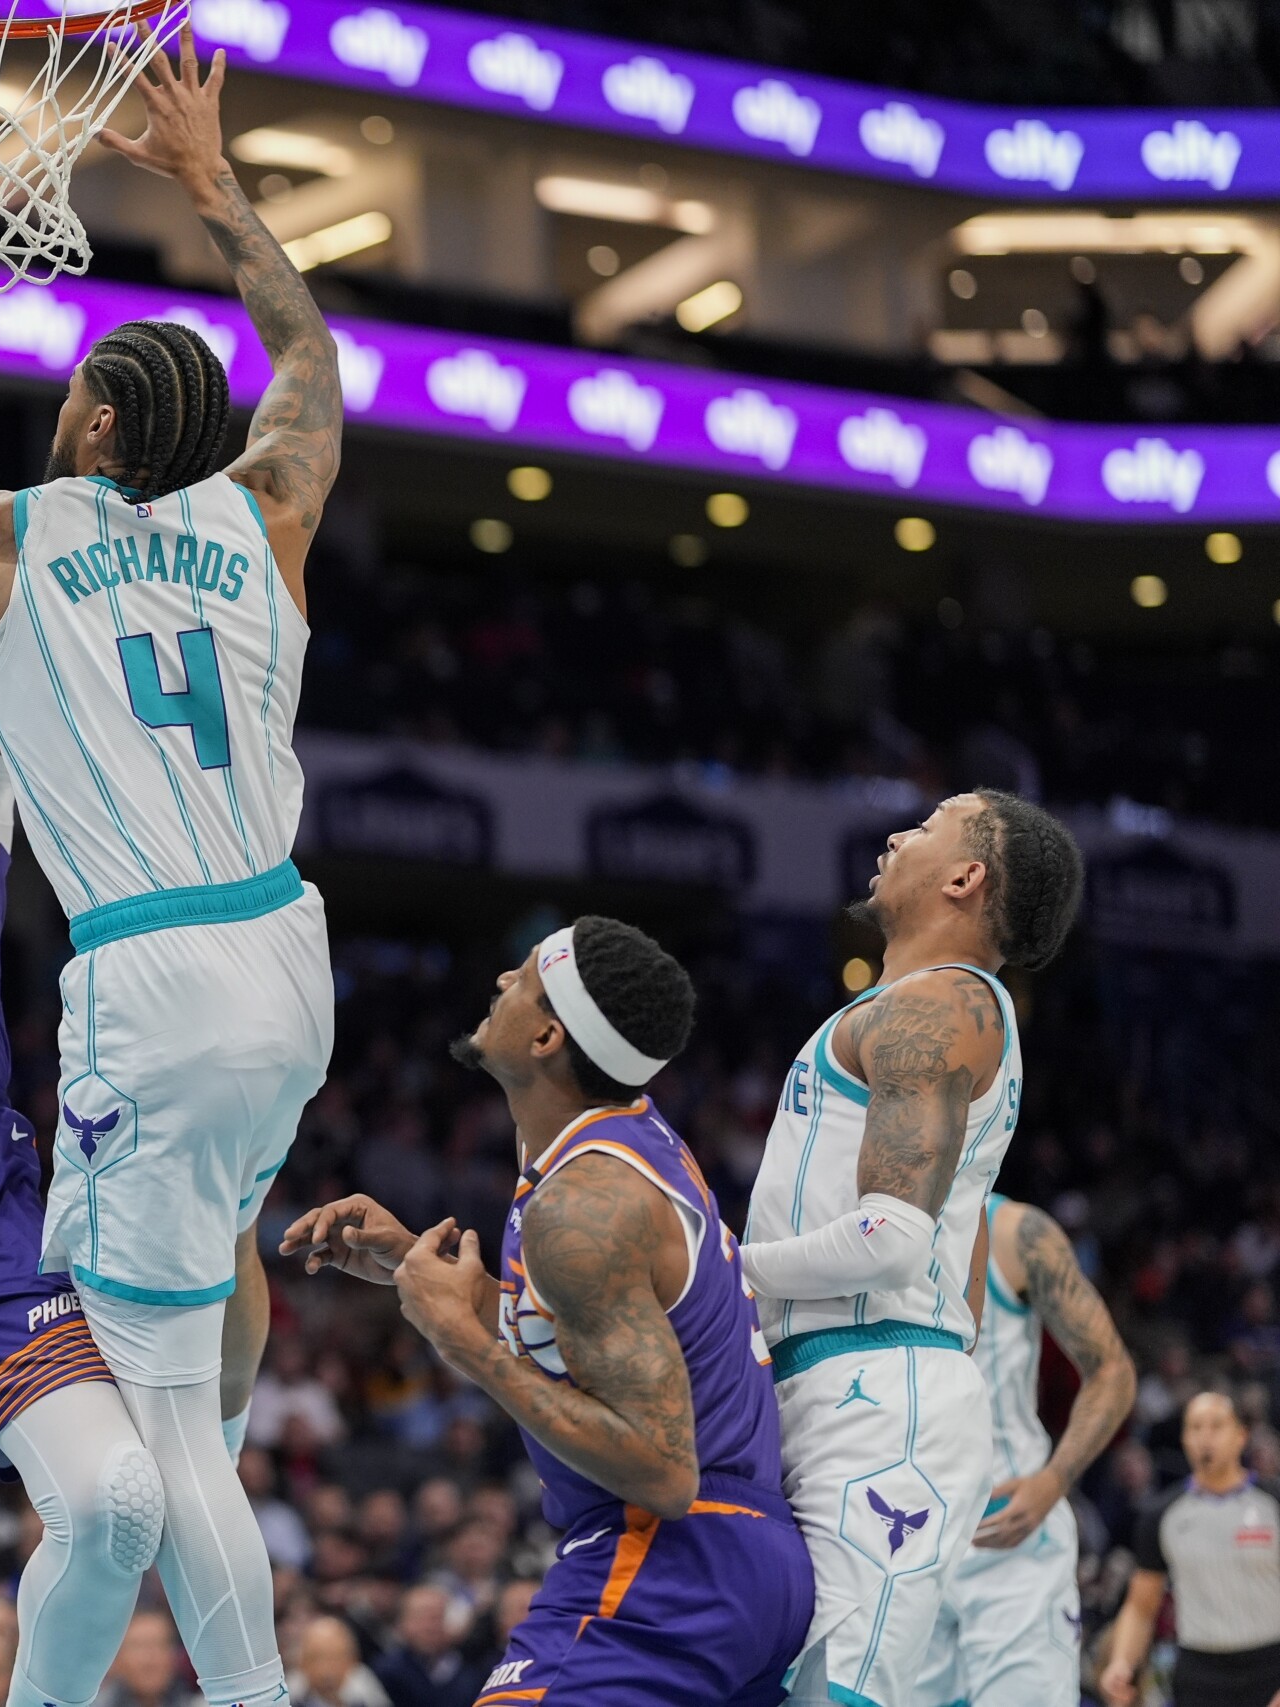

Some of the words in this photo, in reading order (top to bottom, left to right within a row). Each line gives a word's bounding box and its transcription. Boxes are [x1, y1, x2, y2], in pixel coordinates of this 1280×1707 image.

[329, 9, 427, 86] ally
[468, 33, 563, 109] ally
[602, 56, 694, 133] ally
[733, 80, 820, 156] ally
[859, 102, 944, 177] ally
[985, 119, 1083, 190] ally
[1141, 121, 1241, 190] ally
[426, 350, 525, 431] ally
[568, 370, 662, 450] ally
[705, 389, 797, 468] ally
[838, 408, 926, 487] ally
[968, 427, 1052, 504] ally
[1102, 439, 1204, 511] ally
[48, 533, 249, 605] RICHARDS
[116, 627, 231, 770] 4
